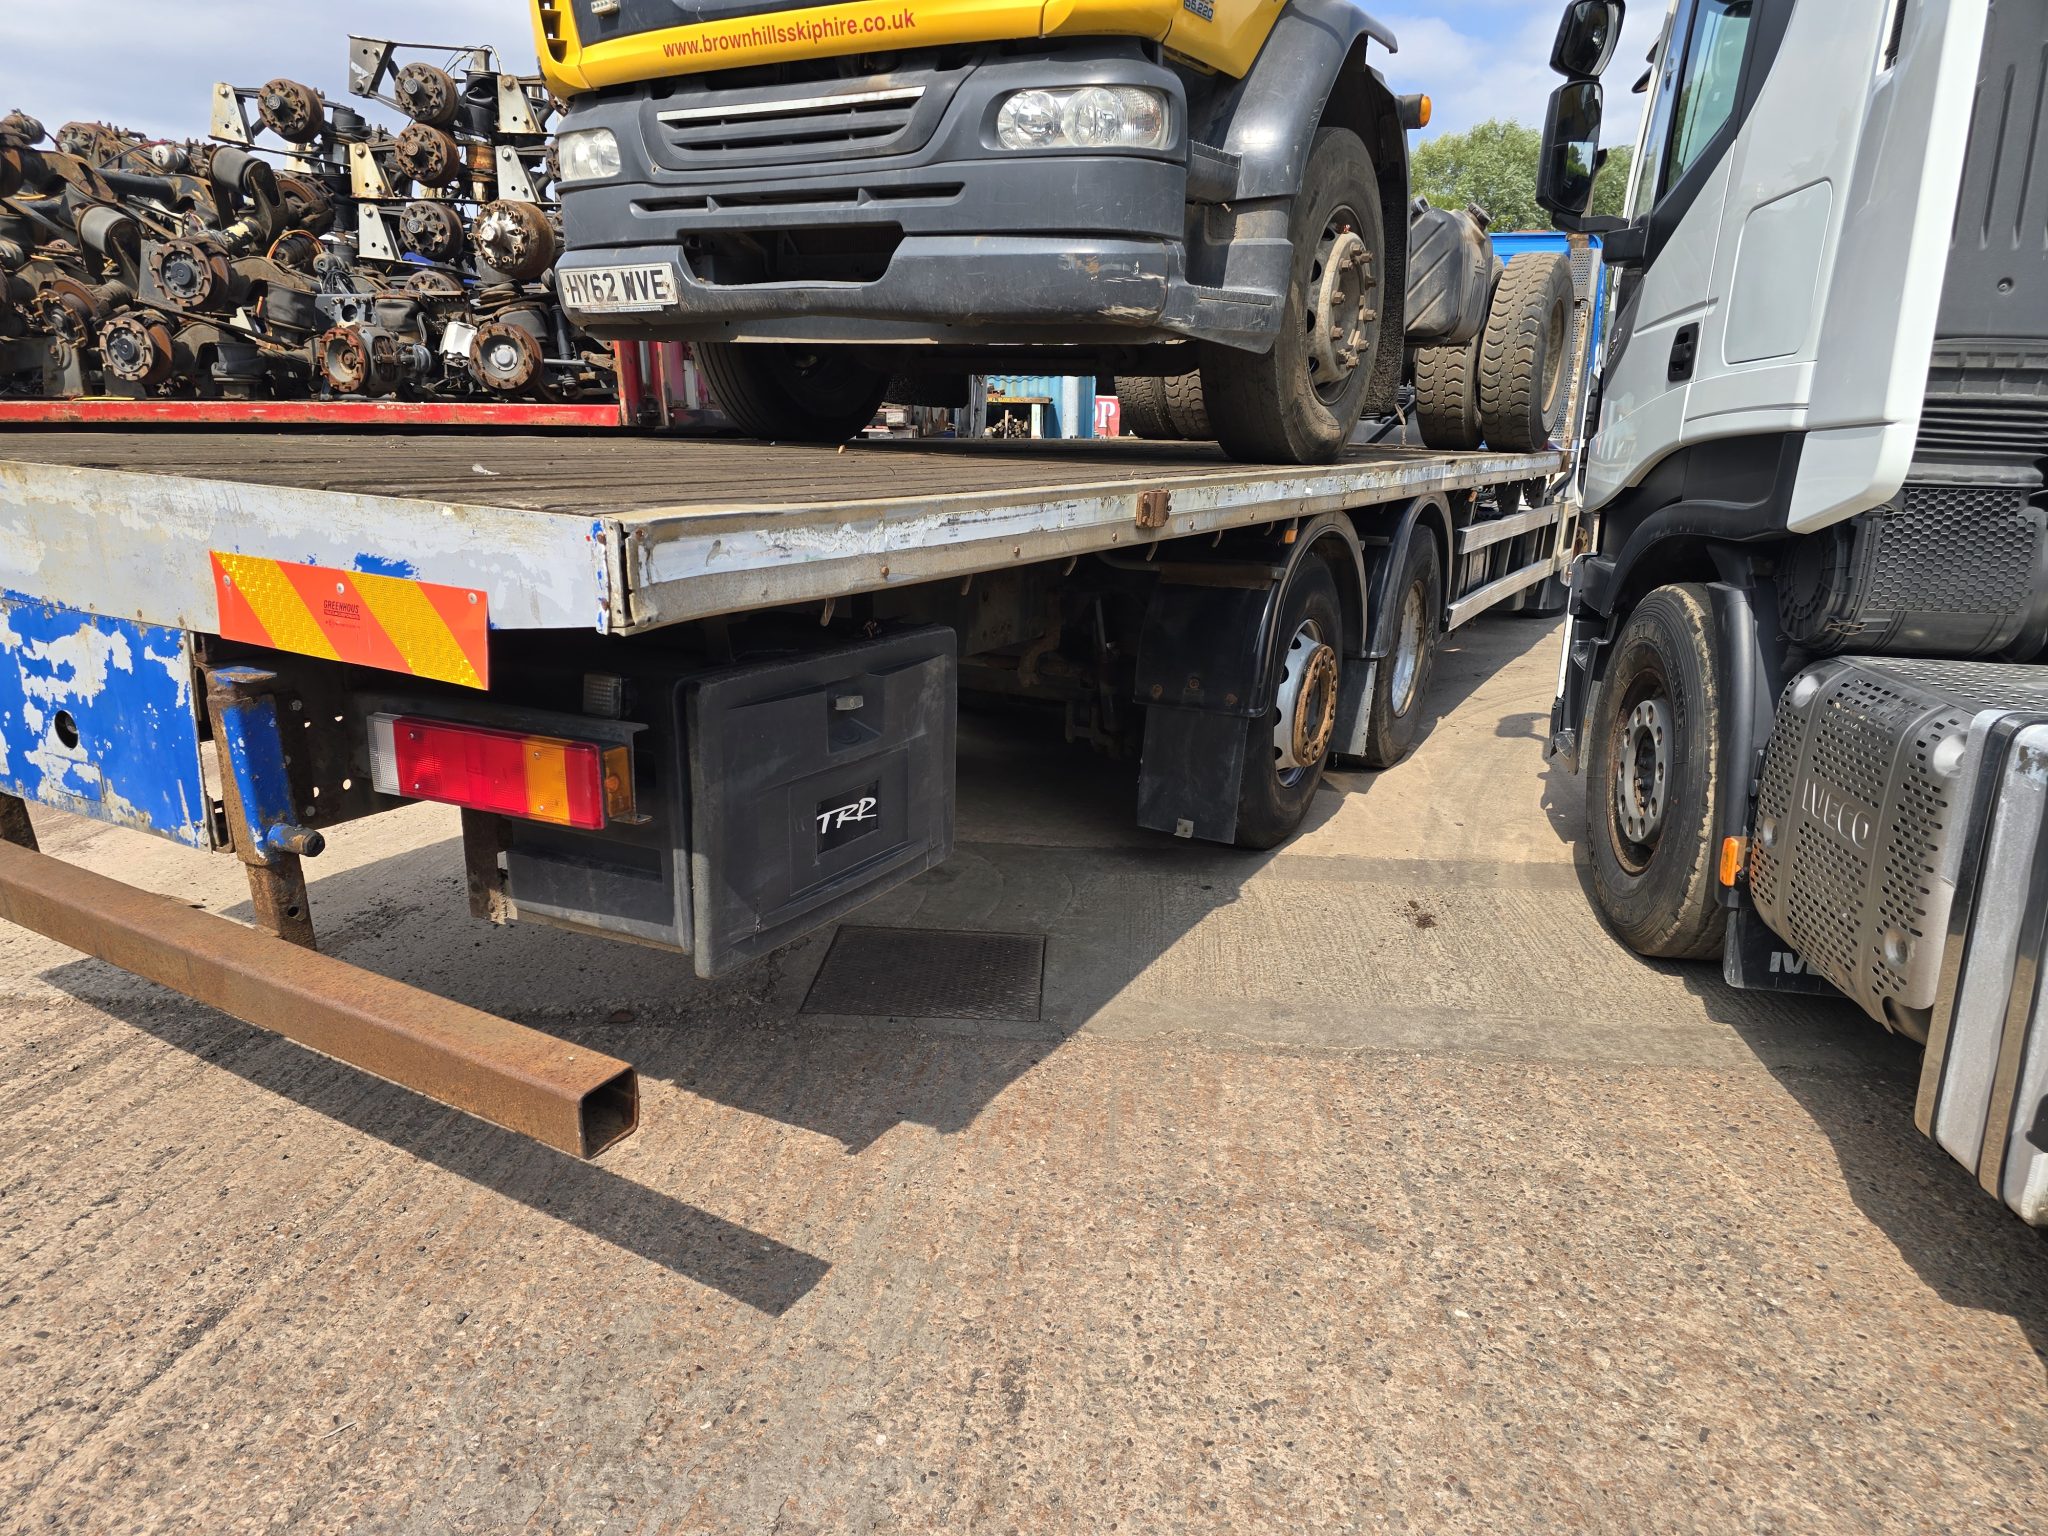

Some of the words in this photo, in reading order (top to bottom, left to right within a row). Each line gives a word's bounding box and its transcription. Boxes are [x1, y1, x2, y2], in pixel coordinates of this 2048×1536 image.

[663, 8, 916, 57] www.brownhillsskiphire.co.uk
[566, 272, 619, 303] HY62
[620, 269, 668, 302] WVE
[323, 599, 360, 614] GREENHOUS
[1801, 777, 1871, 850] IVECO
